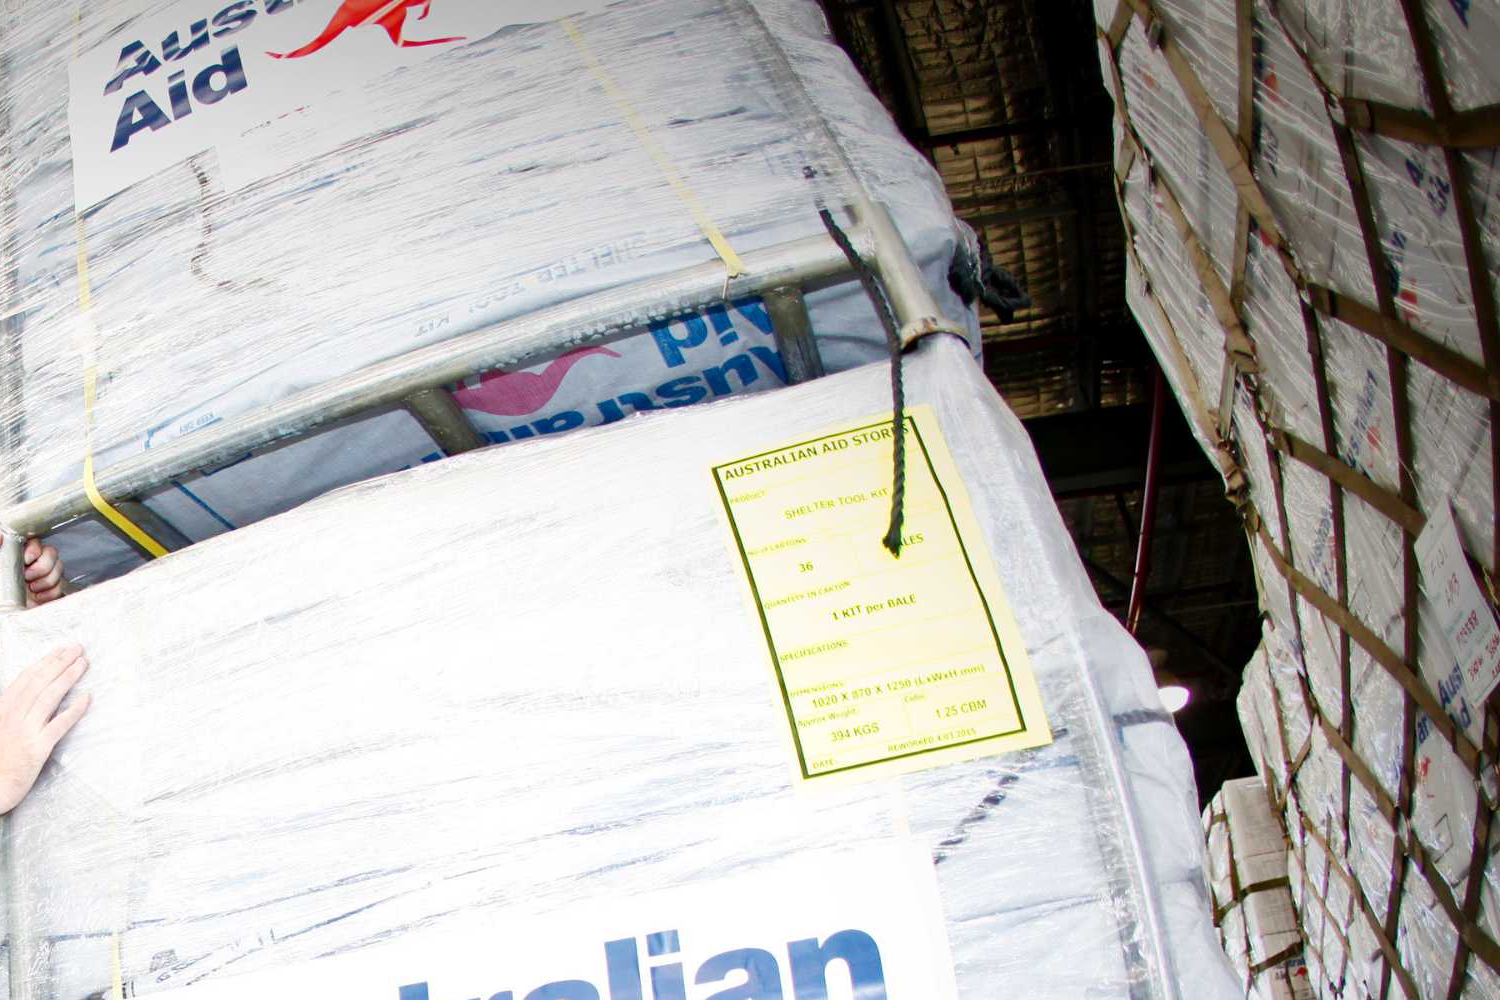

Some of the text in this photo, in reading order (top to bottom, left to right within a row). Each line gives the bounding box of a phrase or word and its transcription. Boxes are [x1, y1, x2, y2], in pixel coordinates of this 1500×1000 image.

[104, 0, 303, 96] Aus
[110, 43, 248, 153] Aid
[725, 423, 909, 480] AUSTRALIAN AID STORS
[784, 487, 889, 520] SHELTER TOOL KIT
[799, 560, 814, 573] 36
[832, 593, 917, 622] 1 KIT per BALE
[812, 695, 838, 709] 1020
[960, 698, 988, 714] CBM
[831, 721, 880, 743] 394 KGS
